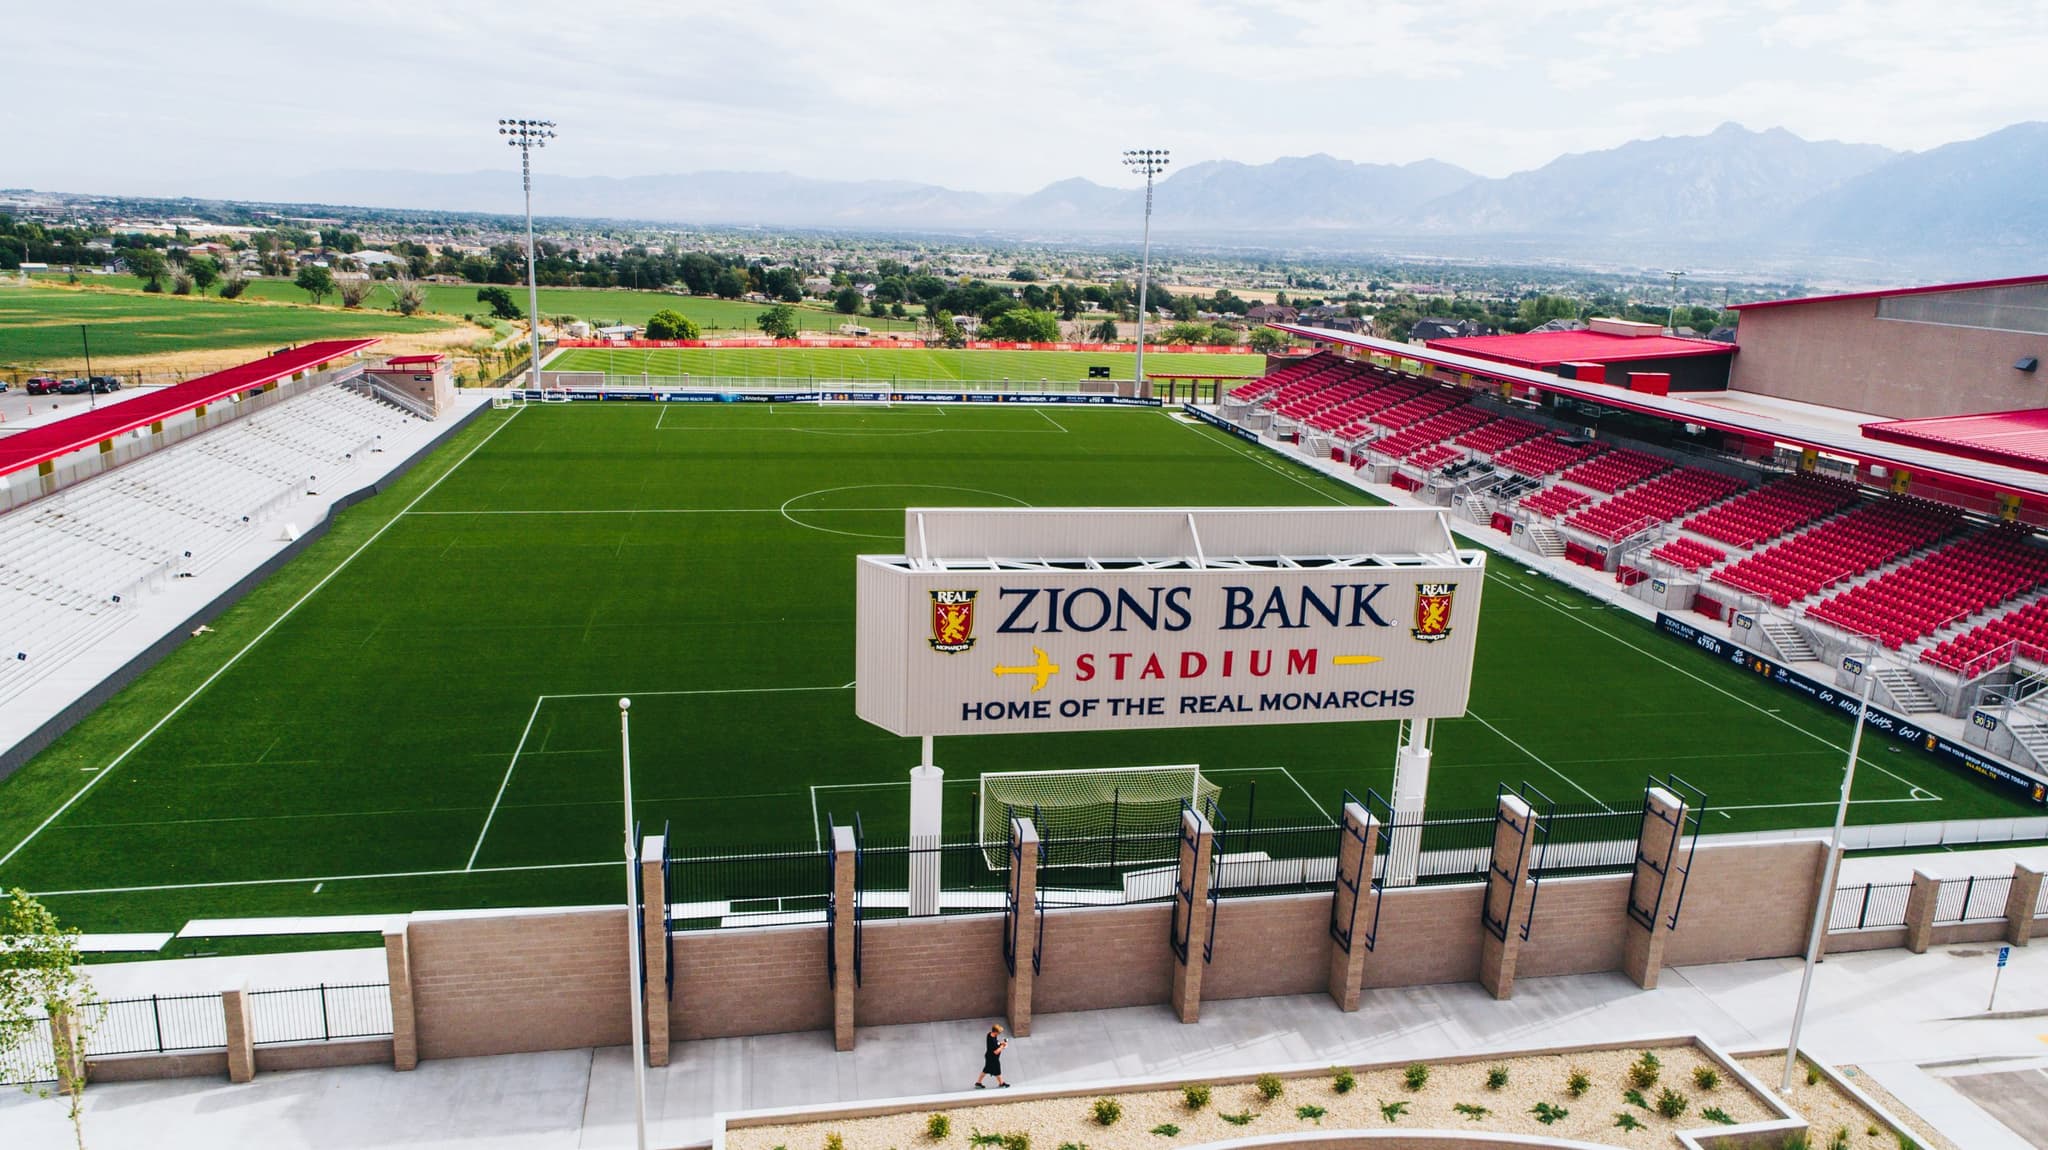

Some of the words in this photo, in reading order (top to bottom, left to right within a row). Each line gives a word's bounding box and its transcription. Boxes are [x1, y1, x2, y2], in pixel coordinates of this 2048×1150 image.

[937, 591, 970, 604] REAL
[1422, 584, 1450, 597] REAL
[996, 586, 1192, 634] ZIONS
[1218, 583, 1390, 631] BANK
[1697, 637, 1714, 651] 4750
[1075, 648, 1318, 681] STADIUM
[962, 700, 1051, 721] HOME
[1060, 699, 1100, 717] OF
[1107, 697, 1166, 716] THE
[1180, 694, 1253, 714] REAL
[1260, 689, 1415, 711] MONARCHS
[1838, 700, 1894, 732] MONRCHS,
[1898, 726, 1921, 742] GO!
